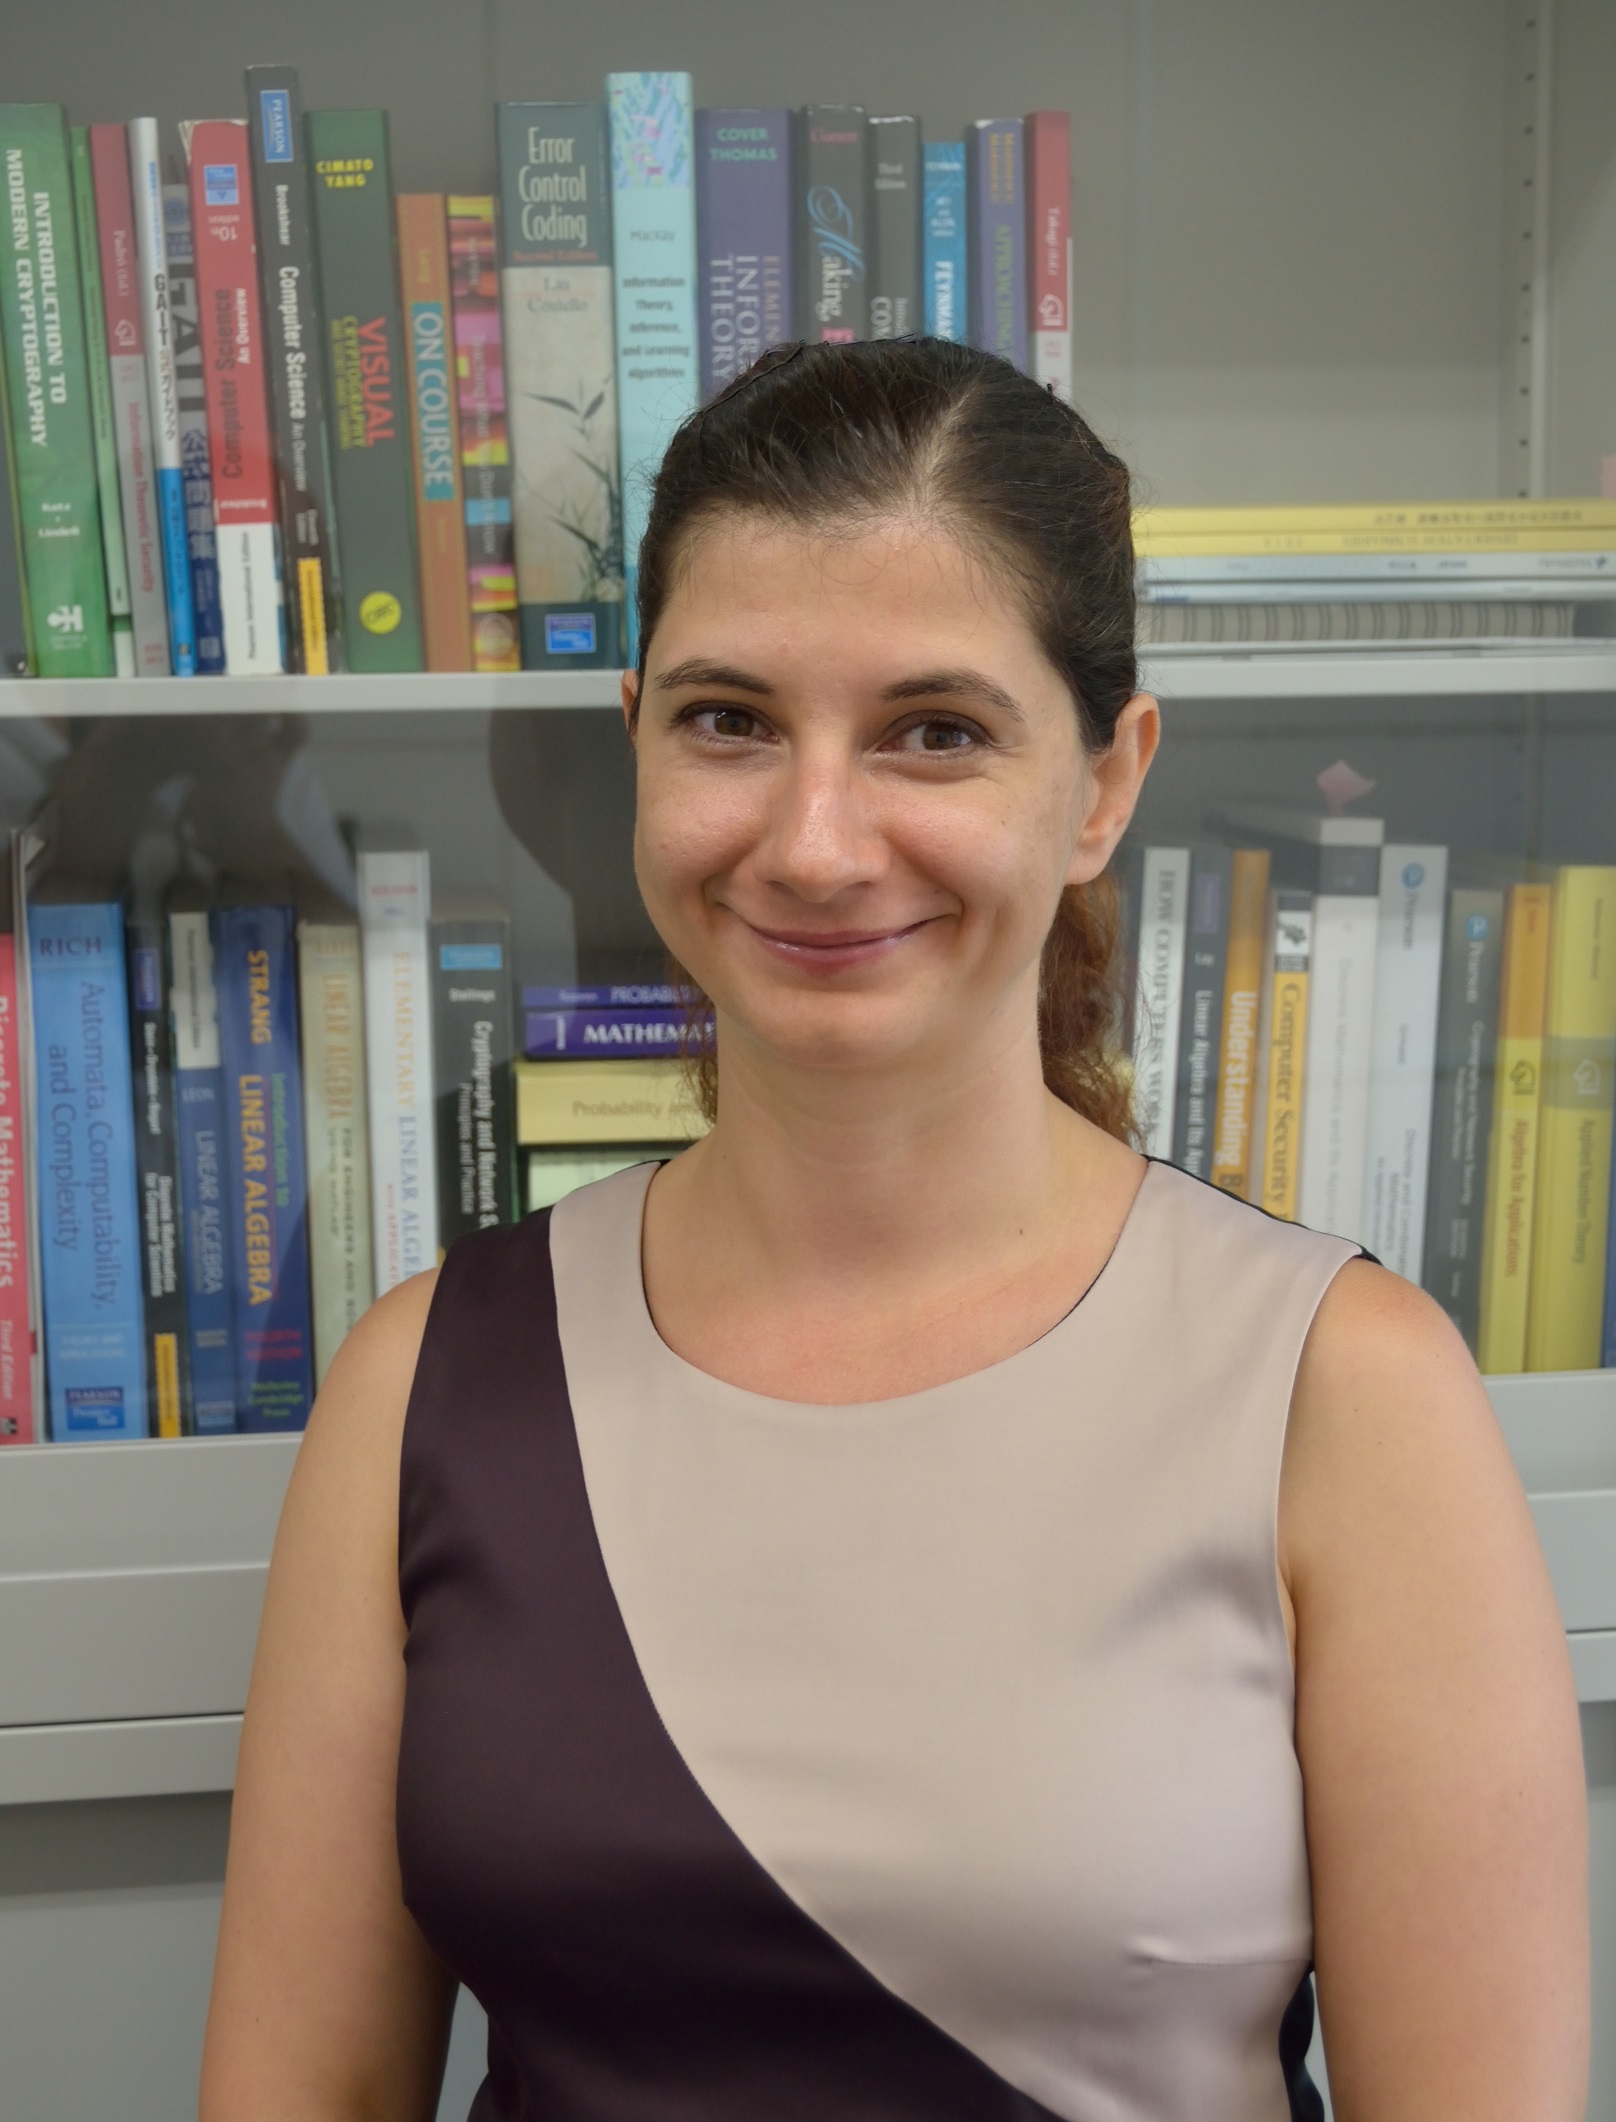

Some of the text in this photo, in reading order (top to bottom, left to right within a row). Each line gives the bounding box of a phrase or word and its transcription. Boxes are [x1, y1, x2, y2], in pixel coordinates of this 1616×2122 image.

[316, 158, 374, 173] CIMATO
[528, 127, 575, 164] Error
[709, 149, 777, 161] THOMAS
[717, 128, 768, 142] COVER
[325, 174, 366, 188] YANG
[519, 165, 587, 203] Control
[521, 204, 588, 248] Coding
[5, 150, 48, 448] MODERN CRYPTOGRAPHY
[33, 192, 67, 404] INTRODUCTION TO
[213, 288, 237, 372] Science
[278, 266, 302, 348] Computer
[710, 253, 737, 378] THEORY
[285, 352, 307, 420] Science
[357, 316, 395, 447] VISUAL
[412, 311, 456, 488] ON COURSE
[218, 379, 245, 478] Computer
[293, 440, 308, 493] Overview
[129, 402, 148, 478] Information
[140, 542, 157, 594] Security
[41, 937, 102, 956] RICH
[1466, 942, 1485, 1003] Pearson
[247, 949, 272, 1045] STRANG
[393, 952, 418, 1108] ELEMENTARY
[584, 1023, 716, 1044] MATHEMA
[1194, 990, 1214, 1036] Linear
[471, 1021, 496, 1119] Cryptography
[1188, 1038, 1211, 1095] Algebra
[1214, 990, 1258, 1169] Understanding
[1264, 983, 1303, 1206] Computer Security
[47, 1044, 82, 1250] and Complexity
[80, 982, 123, 1309] Automata, Computability,
[476, 1121, 497, 1150] and
[572, 1100, 662, 1120] Probability
[1188, 1097, 1206, 1124] and
[1510, 1119, 1532, 1167] Algebra
[240, 1075, 273, 1307] LINEAR ALGEBRA
[398, 1116, 420, 1203] LINEAR
[477, 1151, 498, 1213] Network
[195, 1130, 224, 1295] LINEAR ALGEBRA
[1505, 1195, 1528, 1277] Applications
